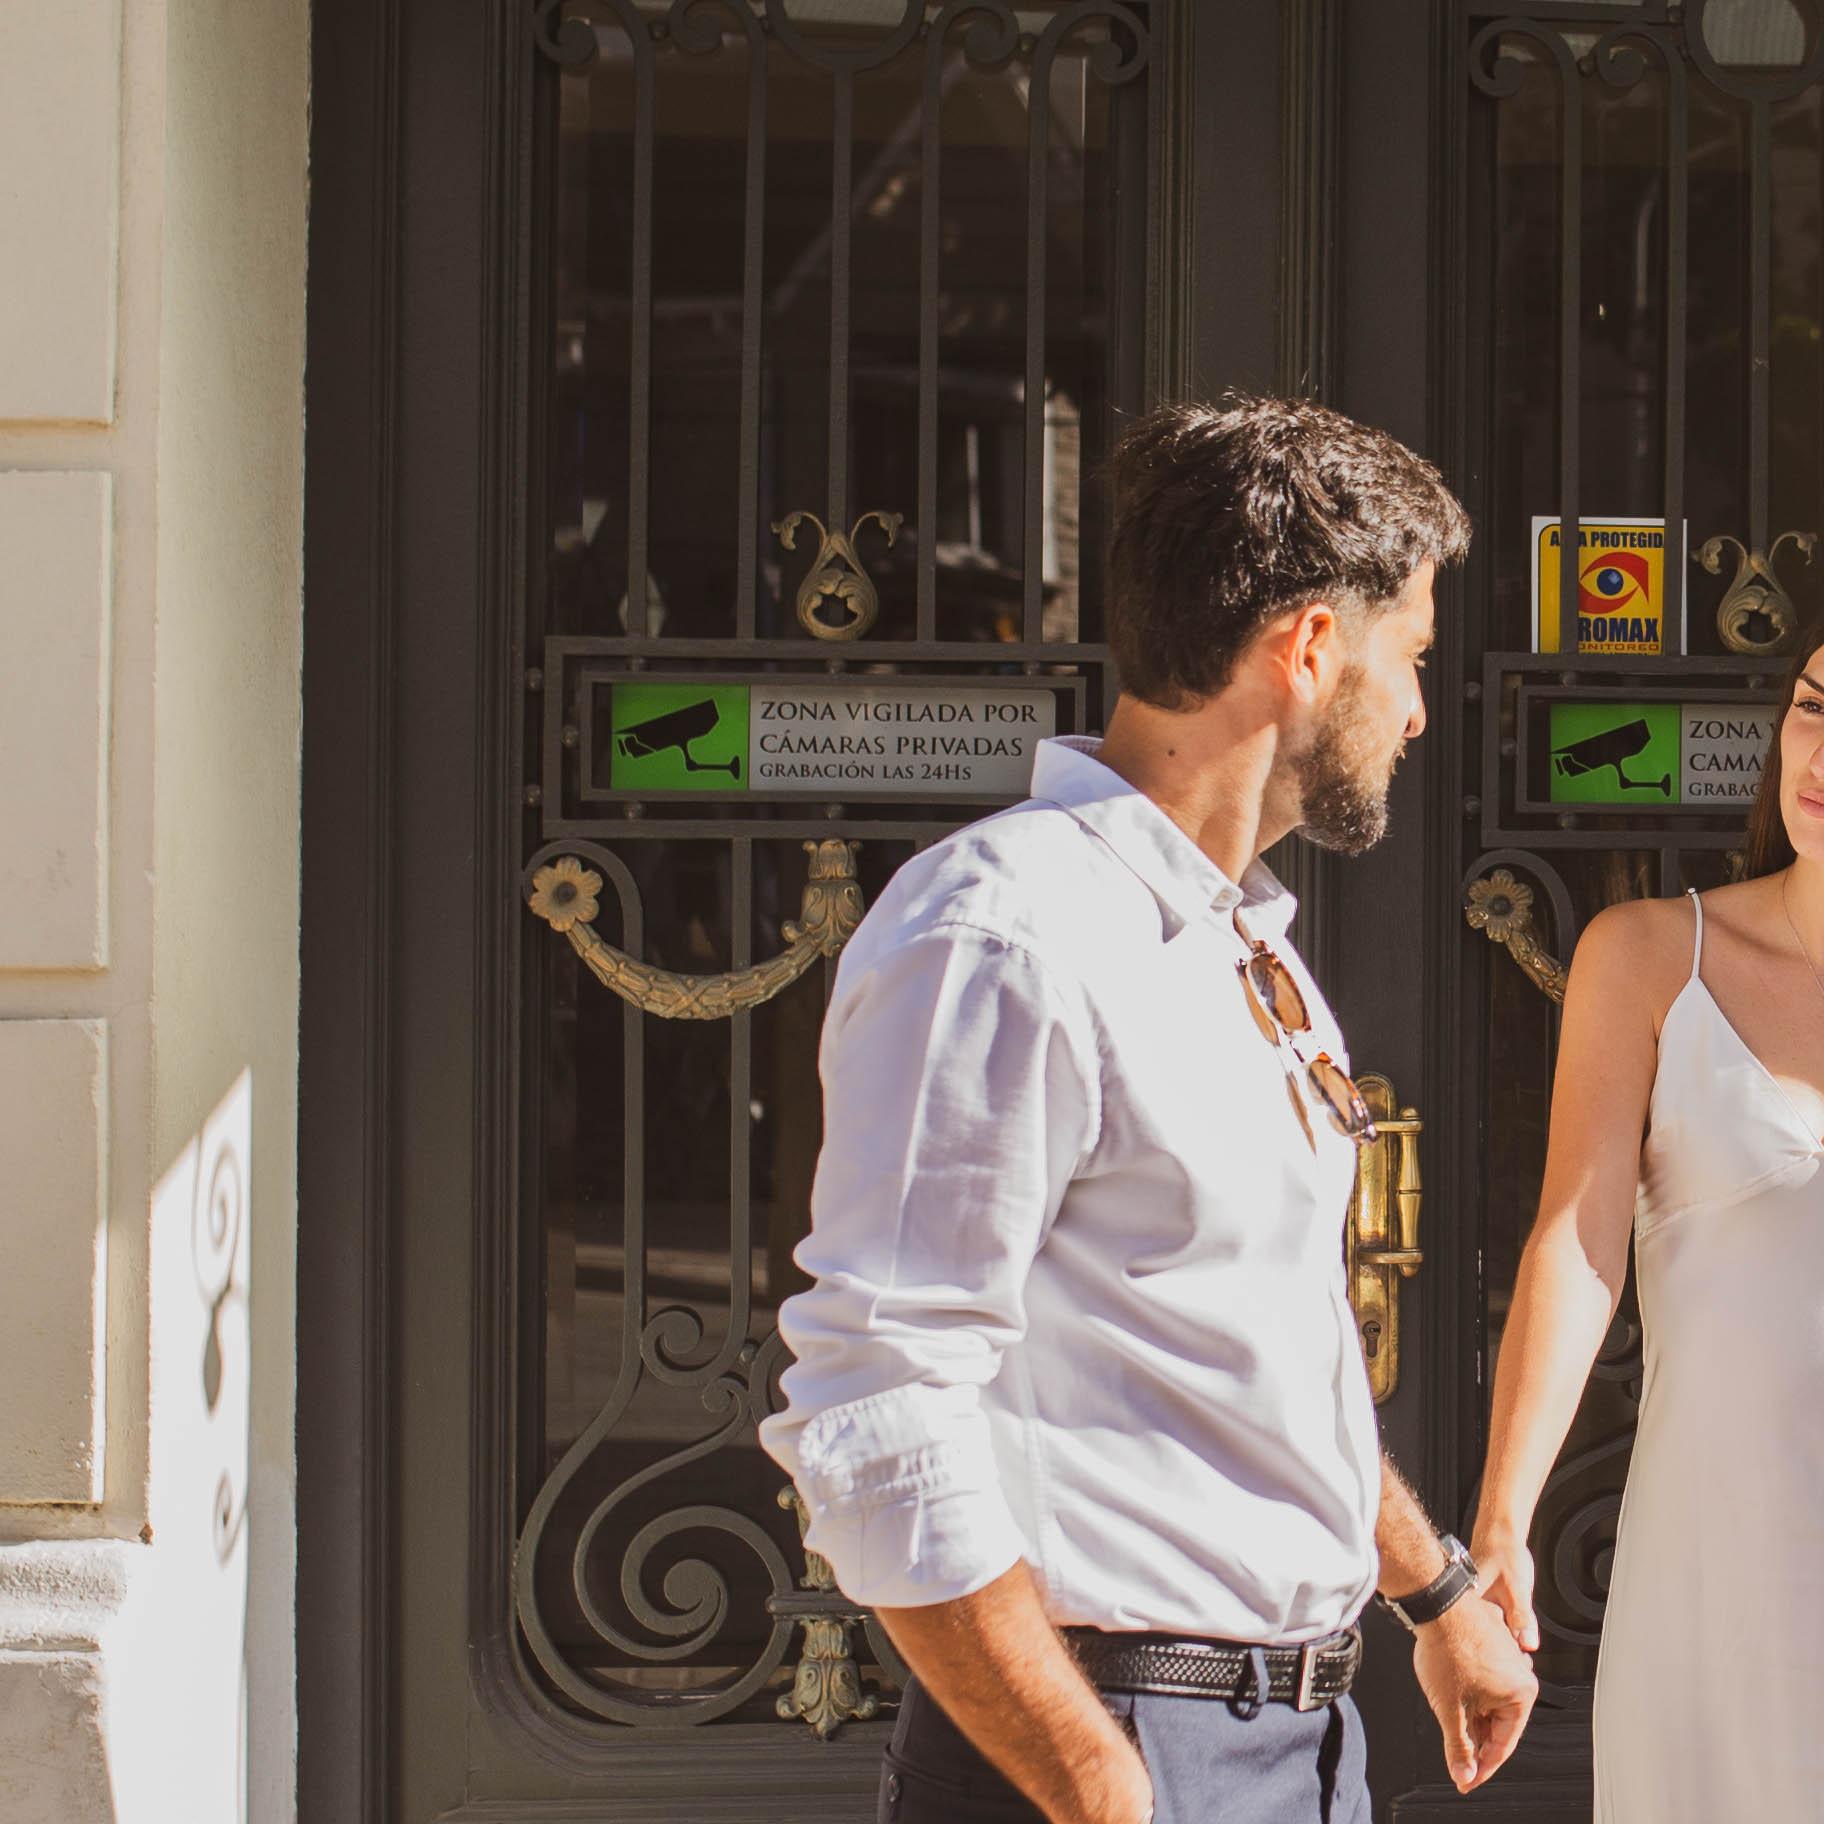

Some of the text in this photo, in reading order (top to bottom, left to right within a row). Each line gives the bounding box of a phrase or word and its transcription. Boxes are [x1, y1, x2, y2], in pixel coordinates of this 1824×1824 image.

[1549, 530, 1665, 549] AA PROTEGID
[1578, 617, 1659, 643] ROMAX
[1578, 643, 1659, 652] ONITOREO
[760, 701, 1038, 724] ZONA VIGILADA POR
[1688, 720, 1763, 740] ZONA
[759, 728, 1023, 757] CÁMARAS PRIVADAS
[759, 760, 875, 779] GRABACIÓN
[882, 764, 914, 780] LAS
[1688, 752, 1761, 772] CAMA
[1688, 782, 1761, 797] GRABAC
